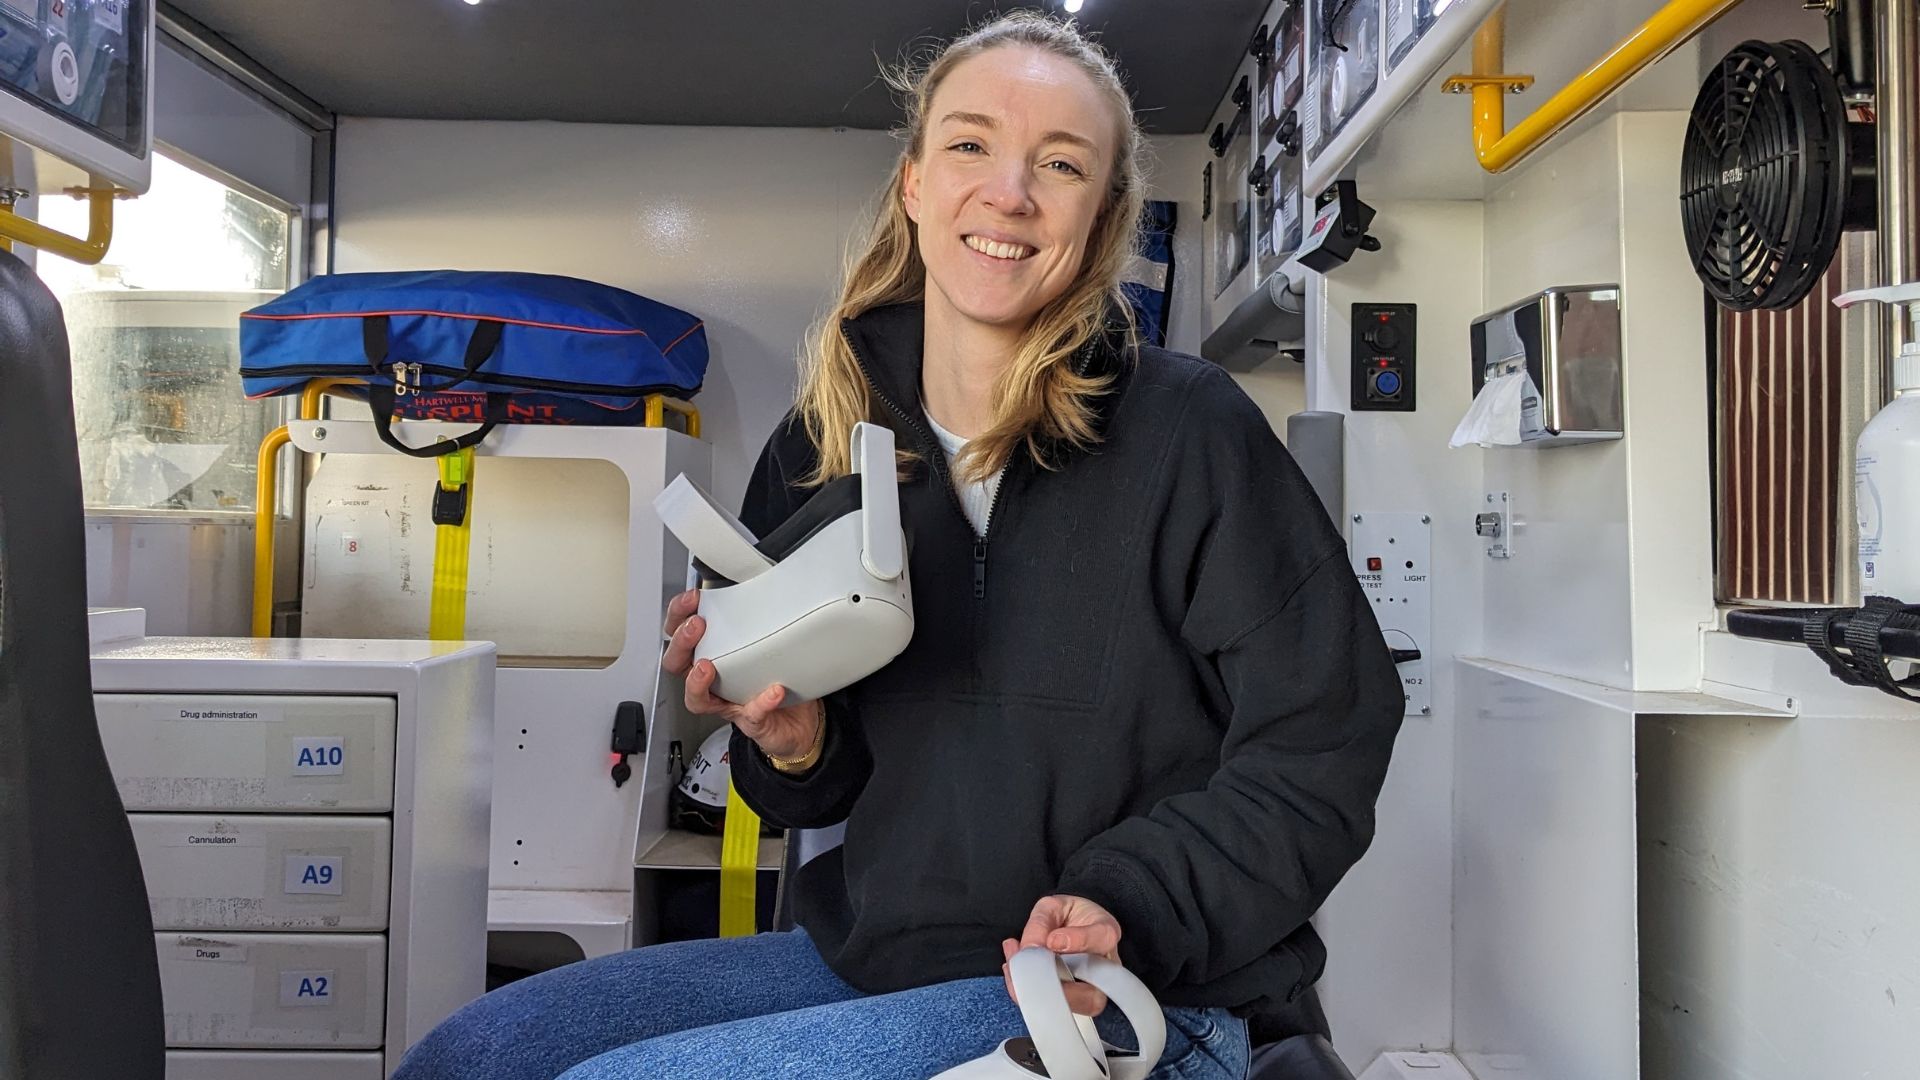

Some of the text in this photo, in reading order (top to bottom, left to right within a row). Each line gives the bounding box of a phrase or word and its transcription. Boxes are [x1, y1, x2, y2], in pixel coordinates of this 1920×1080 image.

[415, 397, 468, 407] HARTWELL
[349, 541, 357, 553] 8
[180, 710, 258, 719] Drug administration
[298, 746, 342, 767] A10
[719, 751, 729, 765] A
[188, 836, 236, 844] Cannulation
[302, 865, 333, 884] A9
[196, 949, 220, 959] Drugs
[298, 977, 328, 997] A2
